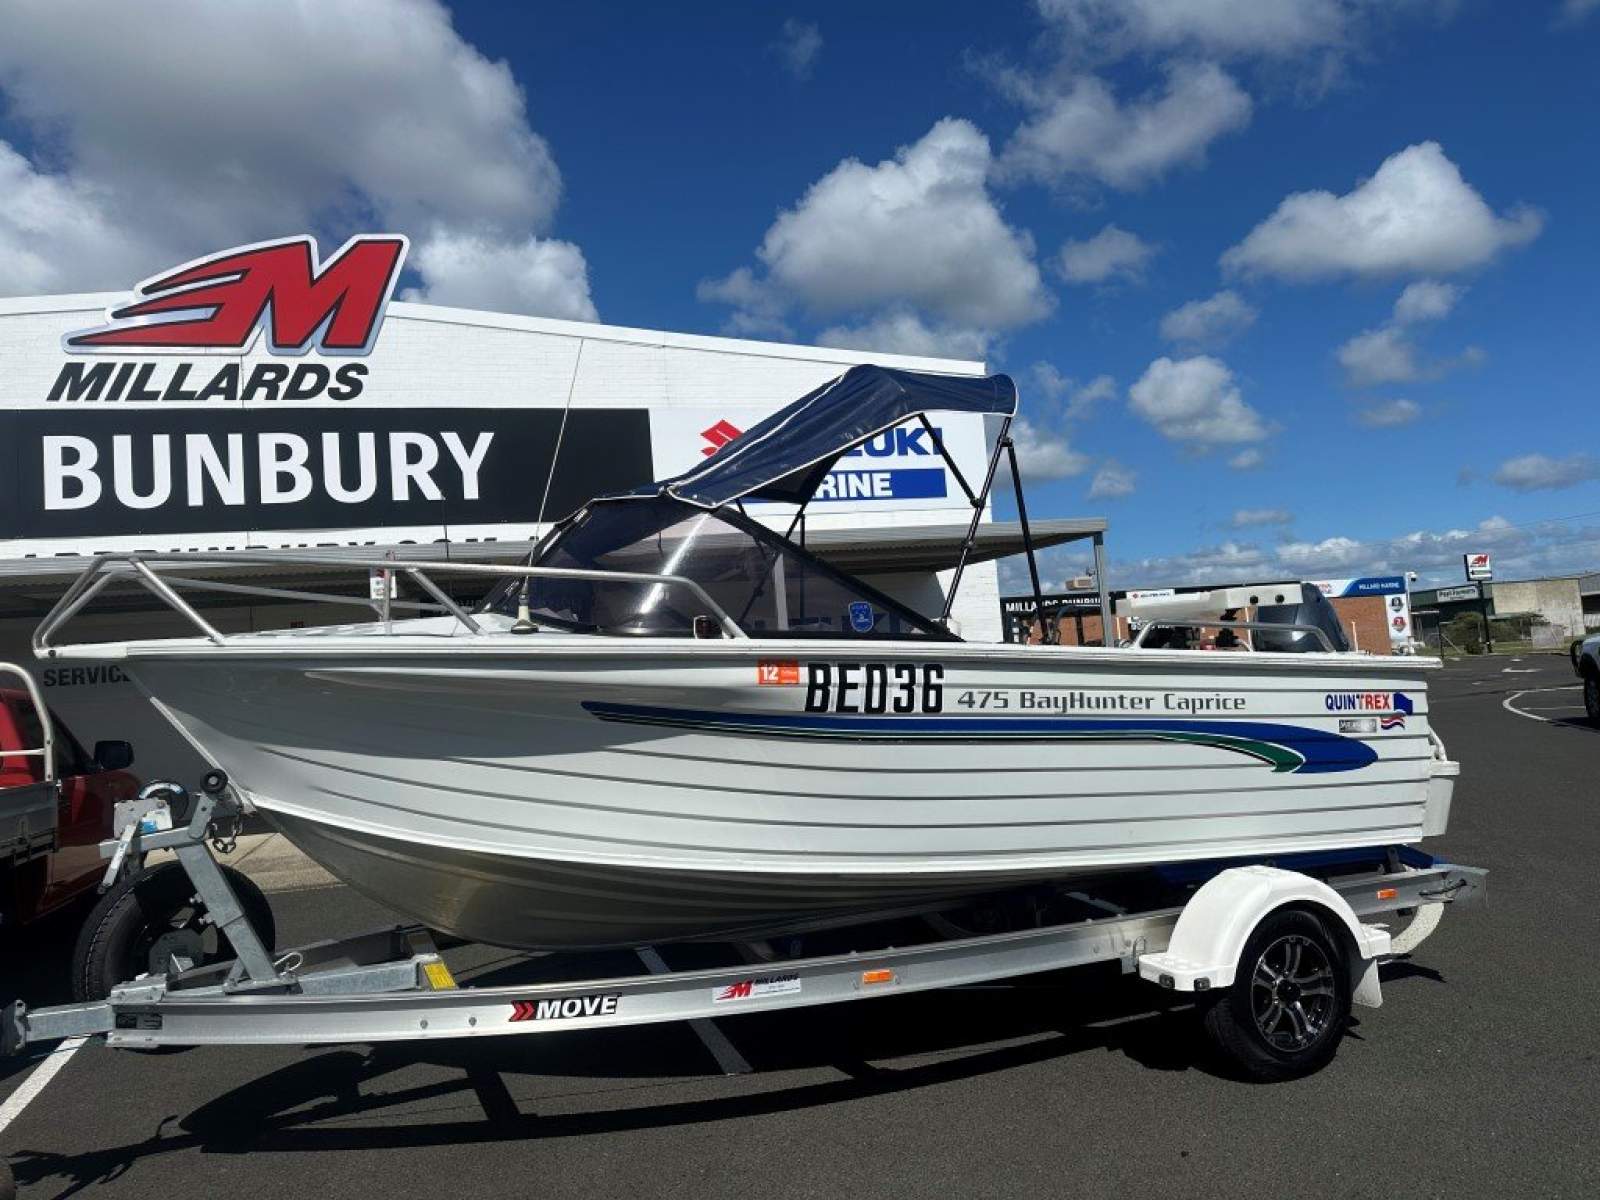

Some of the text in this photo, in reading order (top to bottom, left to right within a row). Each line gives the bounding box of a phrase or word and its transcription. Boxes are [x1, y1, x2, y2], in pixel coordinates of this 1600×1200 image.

[47, 362, 368, 401] MILLARDS
[43, 432, 495, 511] BUNBURY
[813, 472, 893, 498] RINE
[43, 665, 131, 687] SERVIC
[760, 664, 779, 681] 12
[957, 691, 1247, 714] 475 BayHunter Caprice
[1325, 693, 1391, 710] QUINTREX
[536, 995, 617, 1019] MOVE
